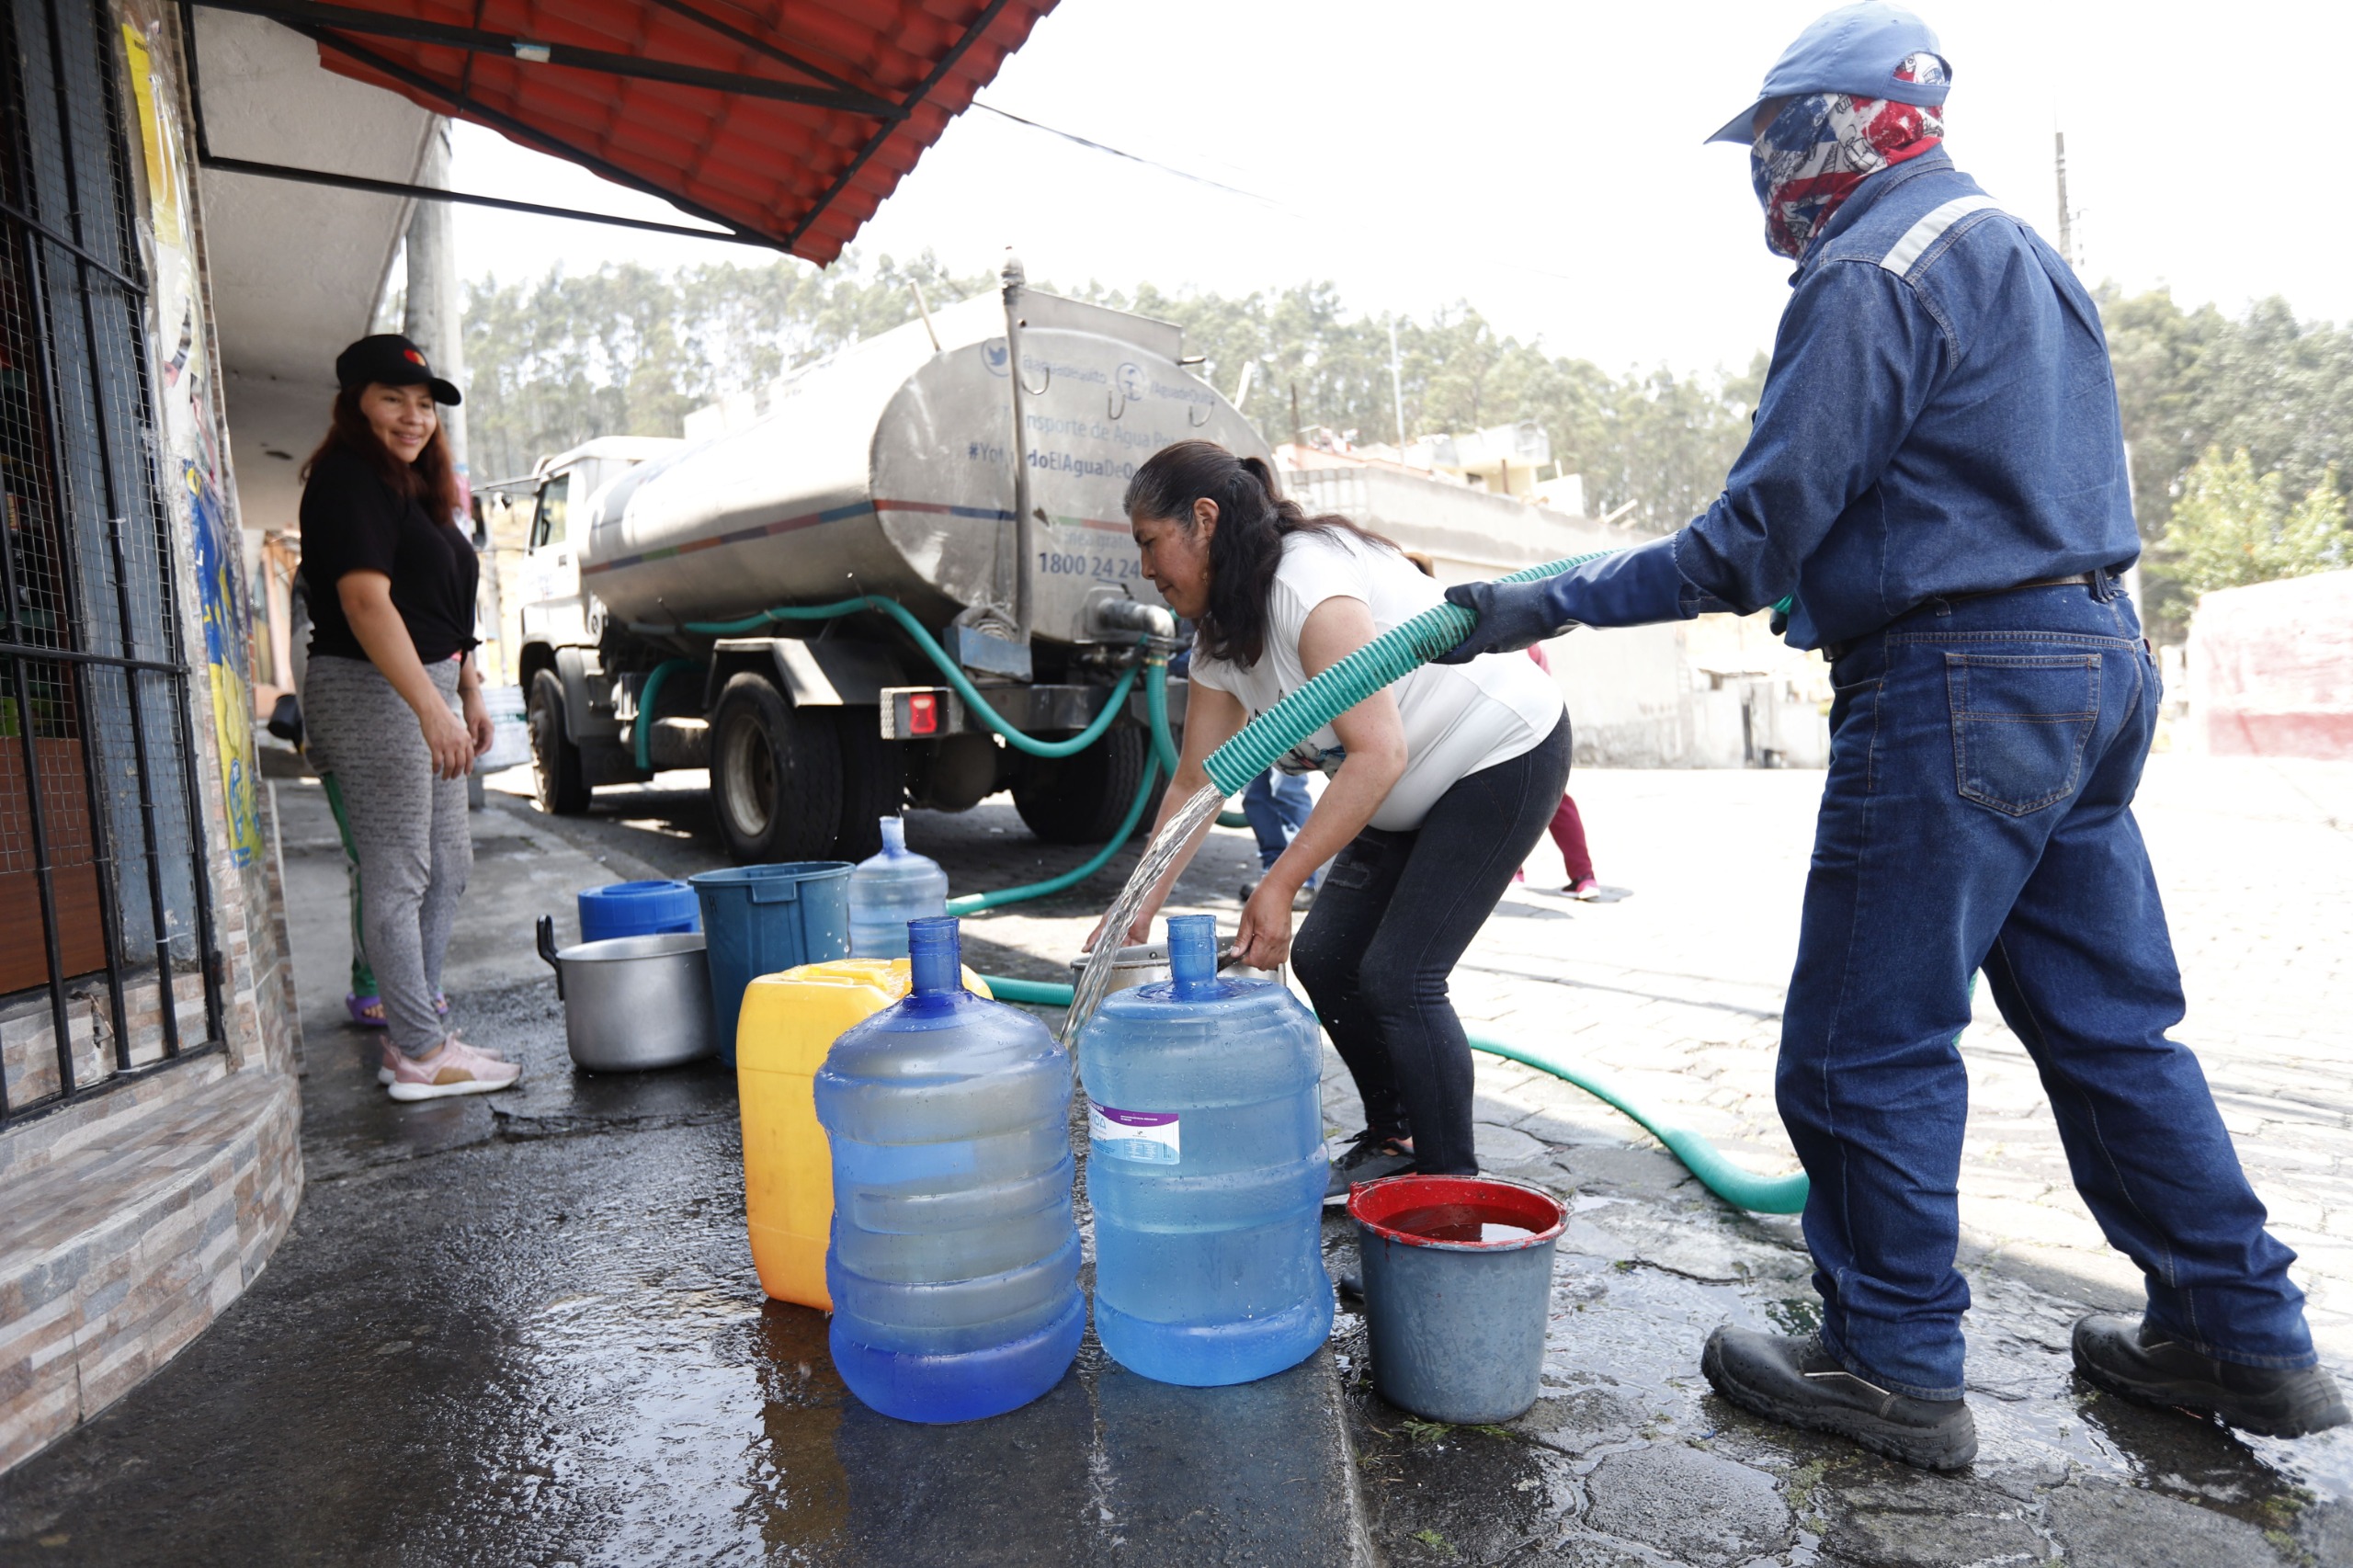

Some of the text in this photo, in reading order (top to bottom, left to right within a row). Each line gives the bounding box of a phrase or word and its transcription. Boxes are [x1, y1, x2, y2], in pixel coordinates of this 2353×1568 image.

[1091, 422, 1109, 441] de
[1113, 425, 1150, 449] Agua
[1039, 552, 1140, 579] 1800 24 24
